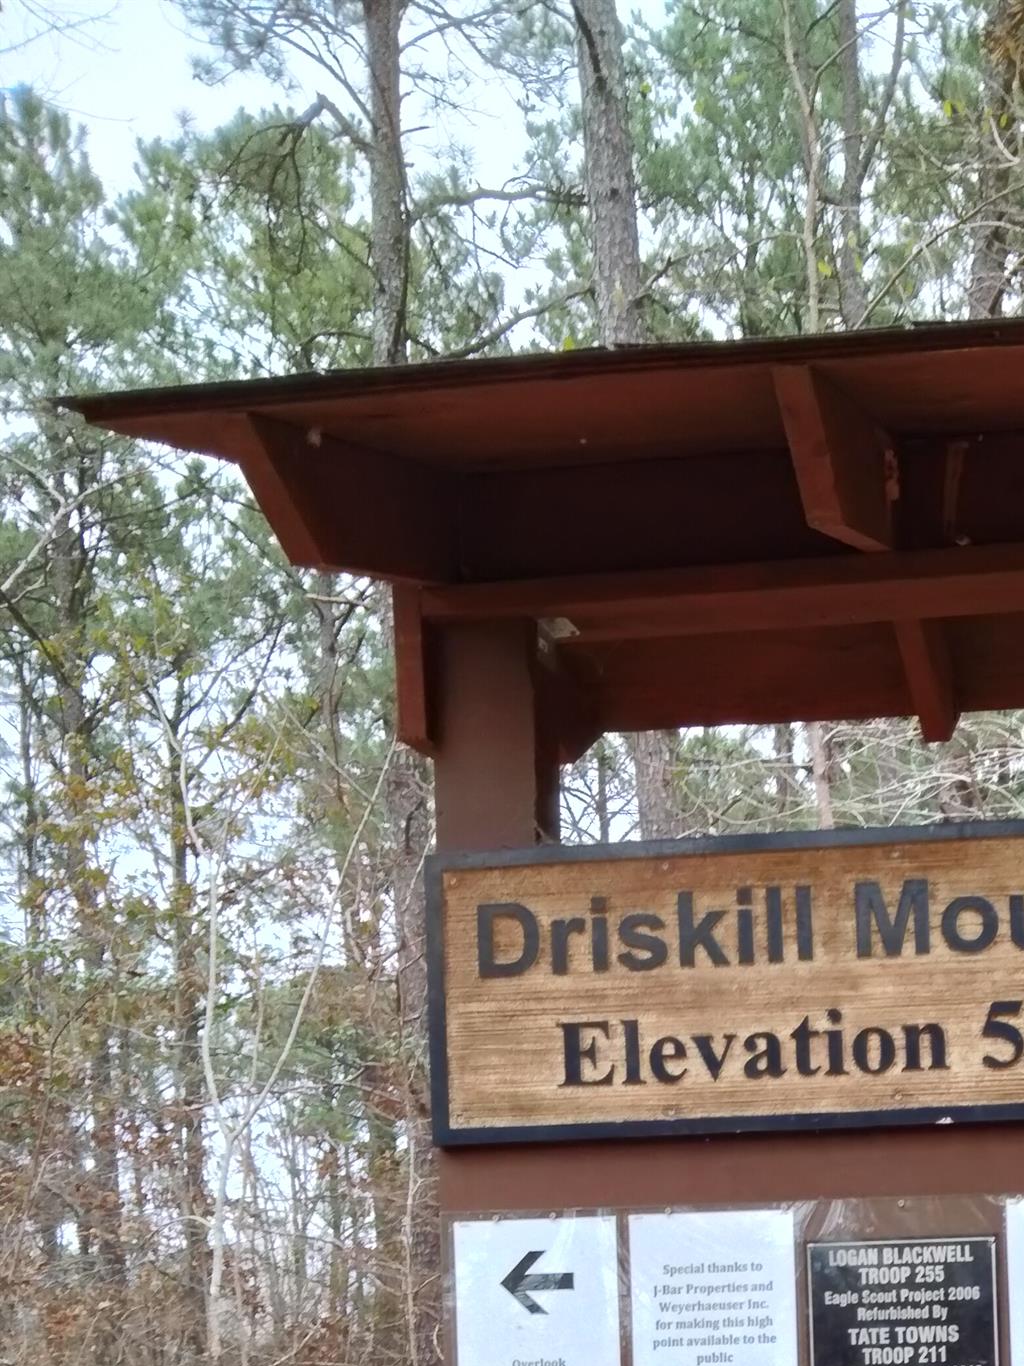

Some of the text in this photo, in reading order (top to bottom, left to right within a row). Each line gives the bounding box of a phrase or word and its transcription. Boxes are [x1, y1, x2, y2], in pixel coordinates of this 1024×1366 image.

[477, 883, 814, 979] Driskill
[558, 1006, 950, 1089] Elevation
[829, 1245, 973, 1266] LOGAN BLACKWELL
[663, 1261, 762, 1276] Special thanks to
[858, 1265, 945, 1285] TROOP 255
[653, 1280, 773, 1297] J-Bar Properties and
[824, 1286, 981, 1307] Eagle Scout Project 2006
[659, 1298, 769, 1314] Weyerhaeuser Inc.
[857, 1305, 948, 1321] Refurbished By
[655, 1315, 773, 1331] for making this high
[653, 1333, 777, 1350] point available to the
[848, 1325, 959, 1345] TATE TOWNS
[697, 1352, 734, 1365] public
[862, 1345, 947, 1365] TROOP 211
